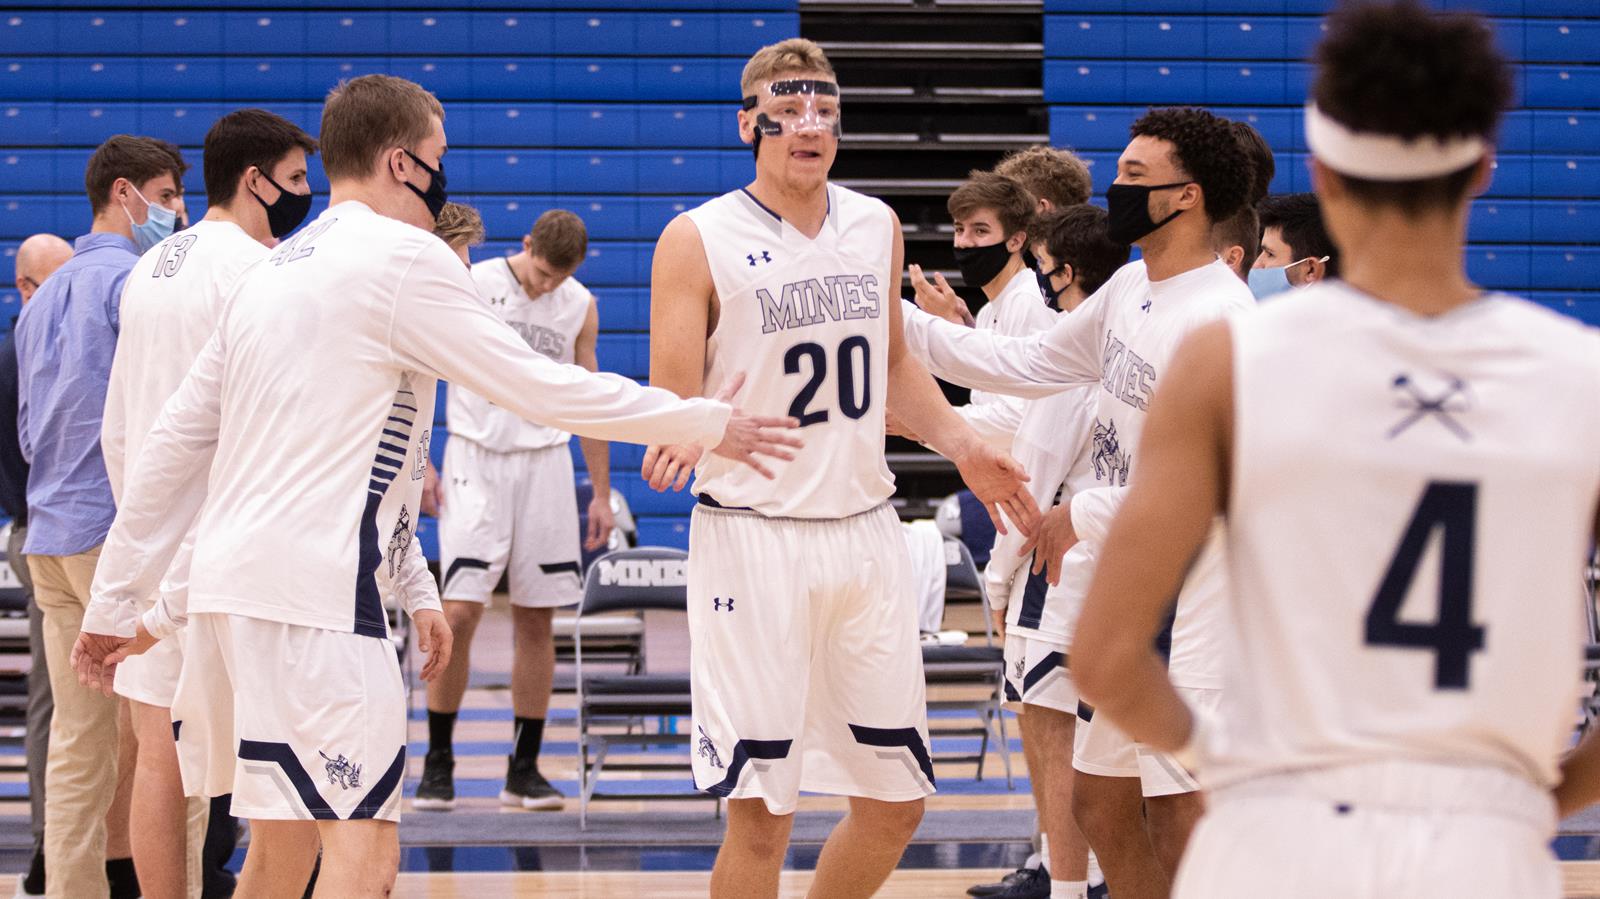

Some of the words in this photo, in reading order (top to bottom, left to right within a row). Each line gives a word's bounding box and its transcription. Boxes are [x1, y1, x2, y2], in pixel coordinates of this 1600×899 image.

[152, 234, 198, 278] 13
[269, 217, 338, 266] 42
[756, 274, 881, 334] MINES
[784, 335, 871, 428] 20
[1362, 479, 1487, 690] 4
